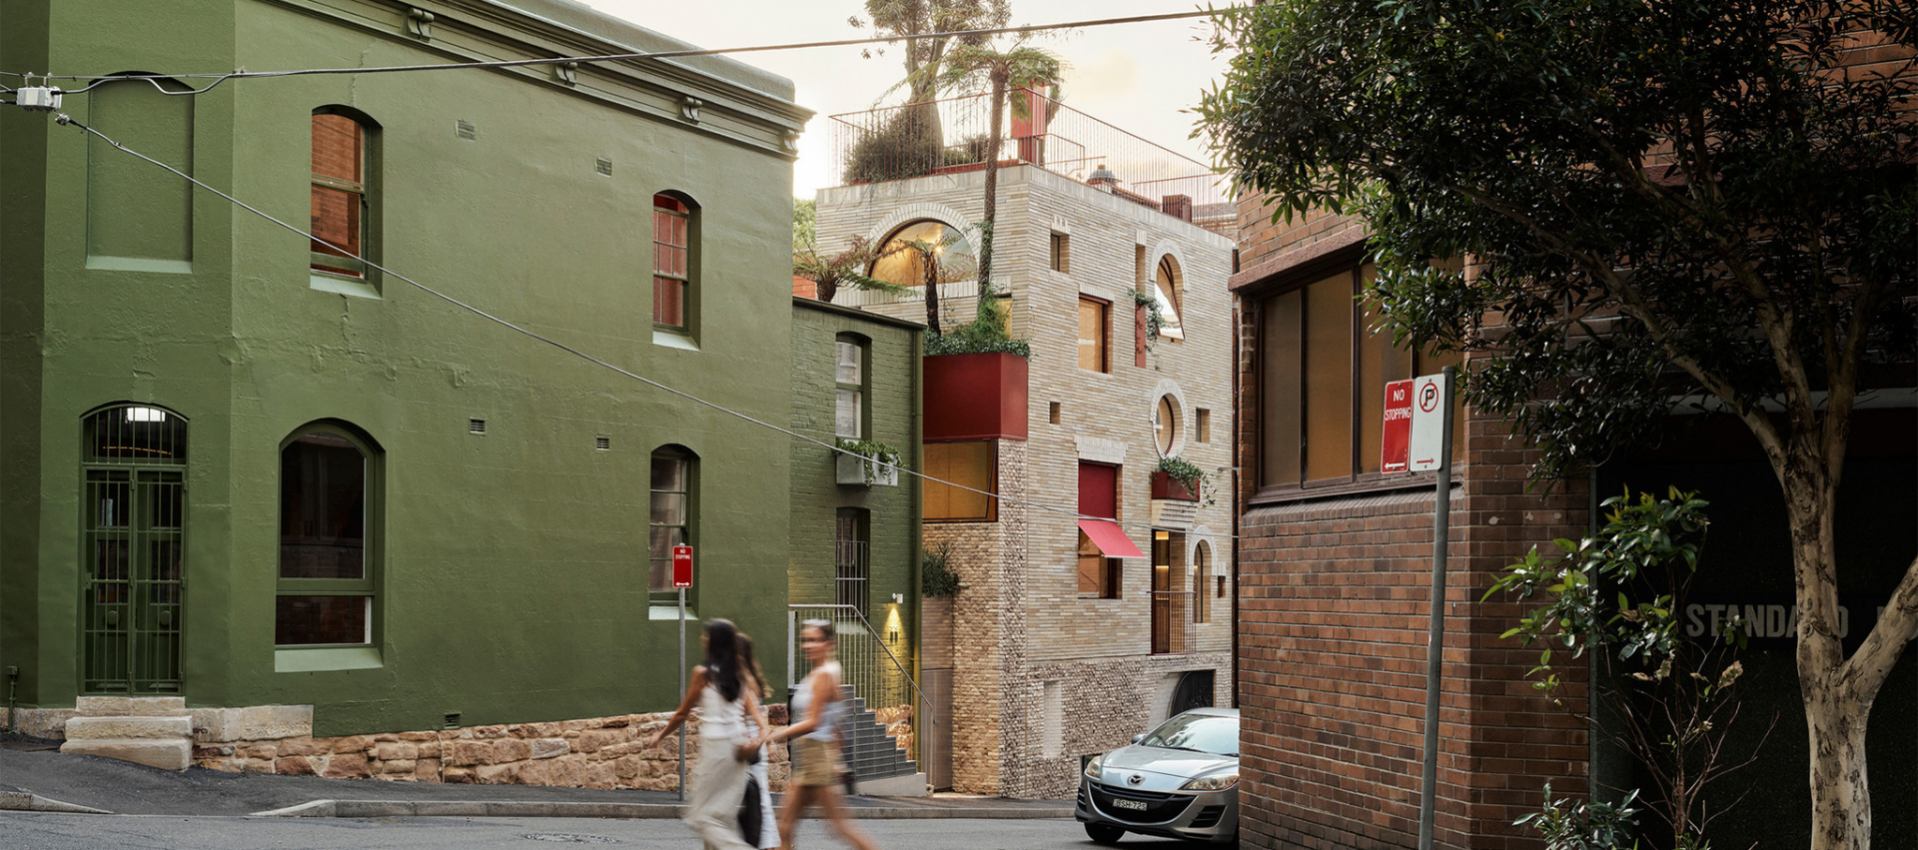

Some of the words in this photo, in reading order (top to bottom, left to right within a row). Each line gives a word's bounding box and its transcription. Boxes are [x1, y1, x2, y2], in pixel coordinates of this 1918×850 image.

[1393, 389, 1405, 402] NO
[1384, 407, 1411, 421] STOPPING
[1685, 603, 1849, 638] STANDA
